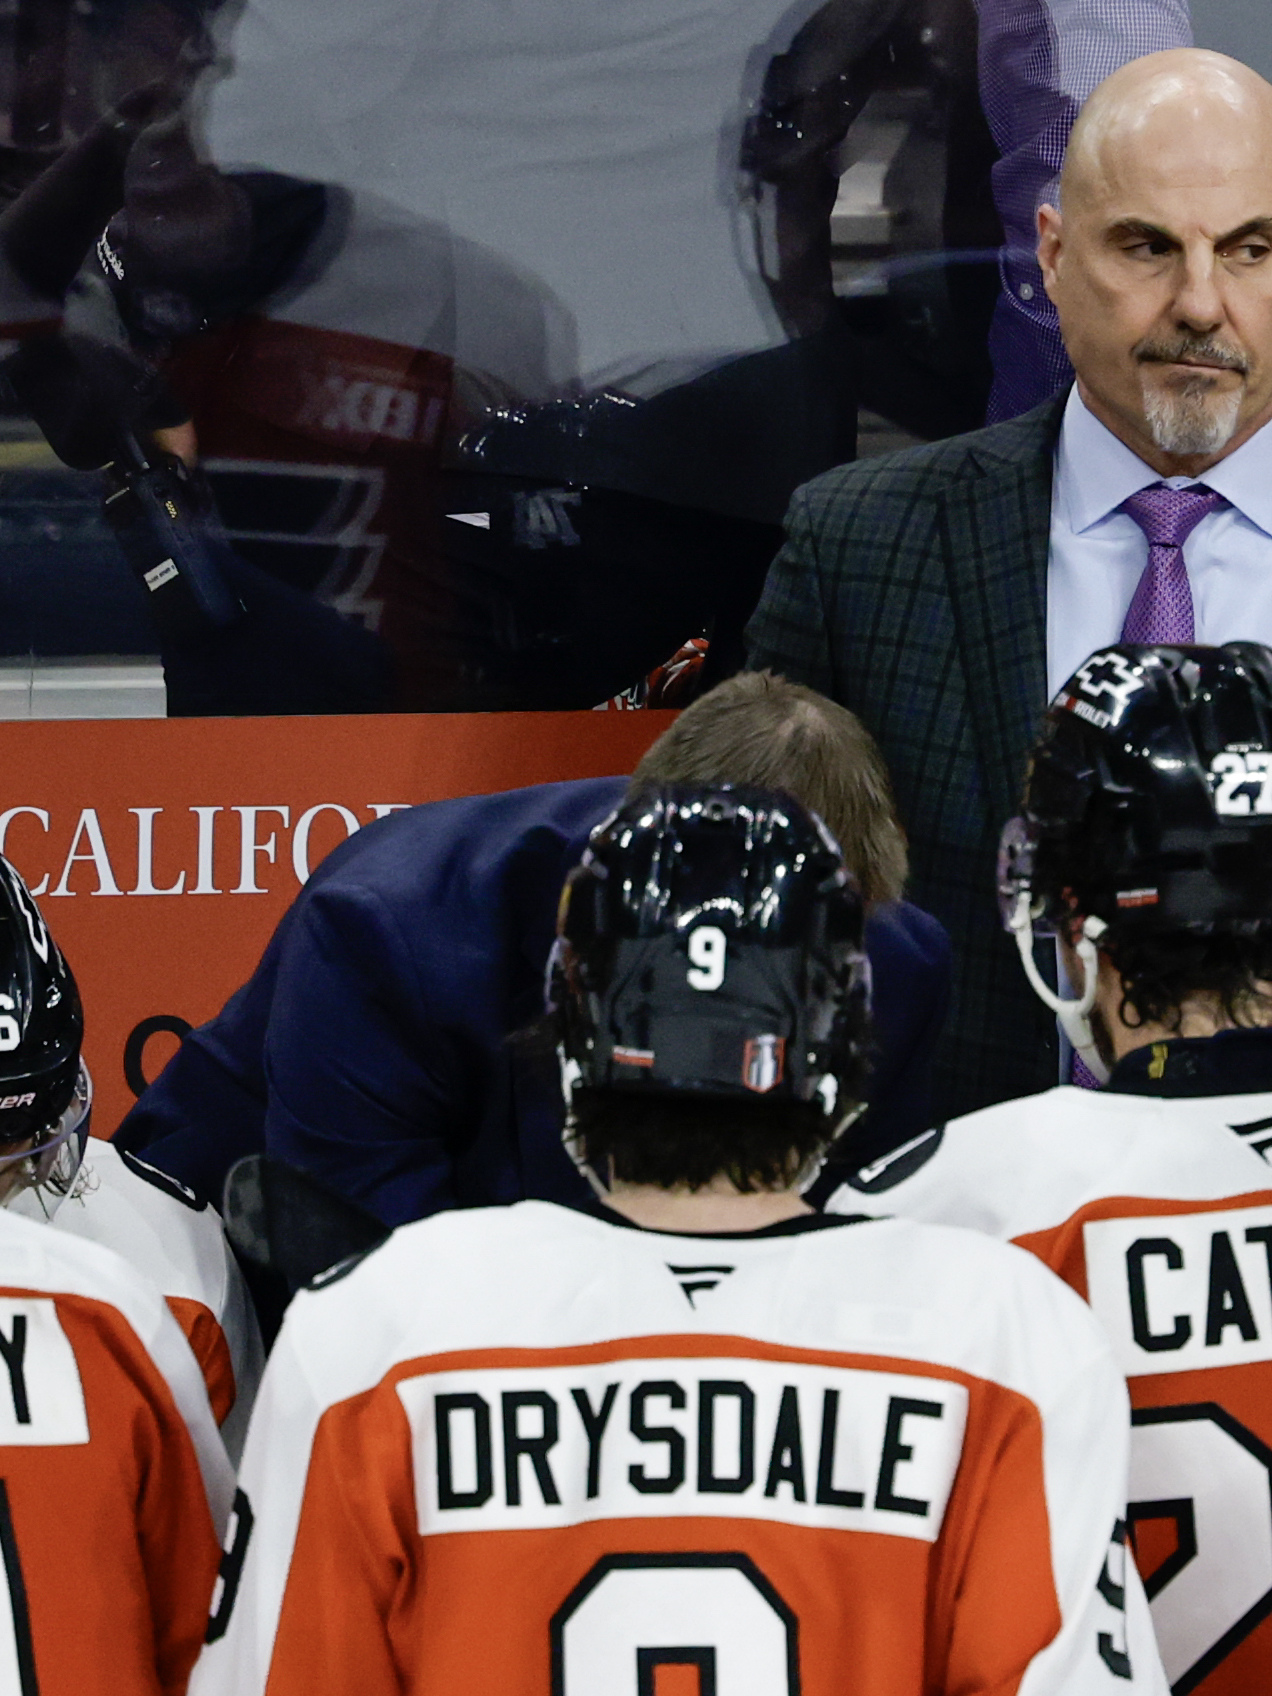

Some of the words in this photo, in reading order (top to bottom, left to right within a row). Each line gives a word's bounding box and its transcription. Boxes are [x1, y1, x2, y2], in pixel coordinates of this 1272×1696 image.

[1, 803, 413, 896] CALIFO
[687, 926, 727, 991] 9
[434, 1380, 943, 1516] DRYSDALE
